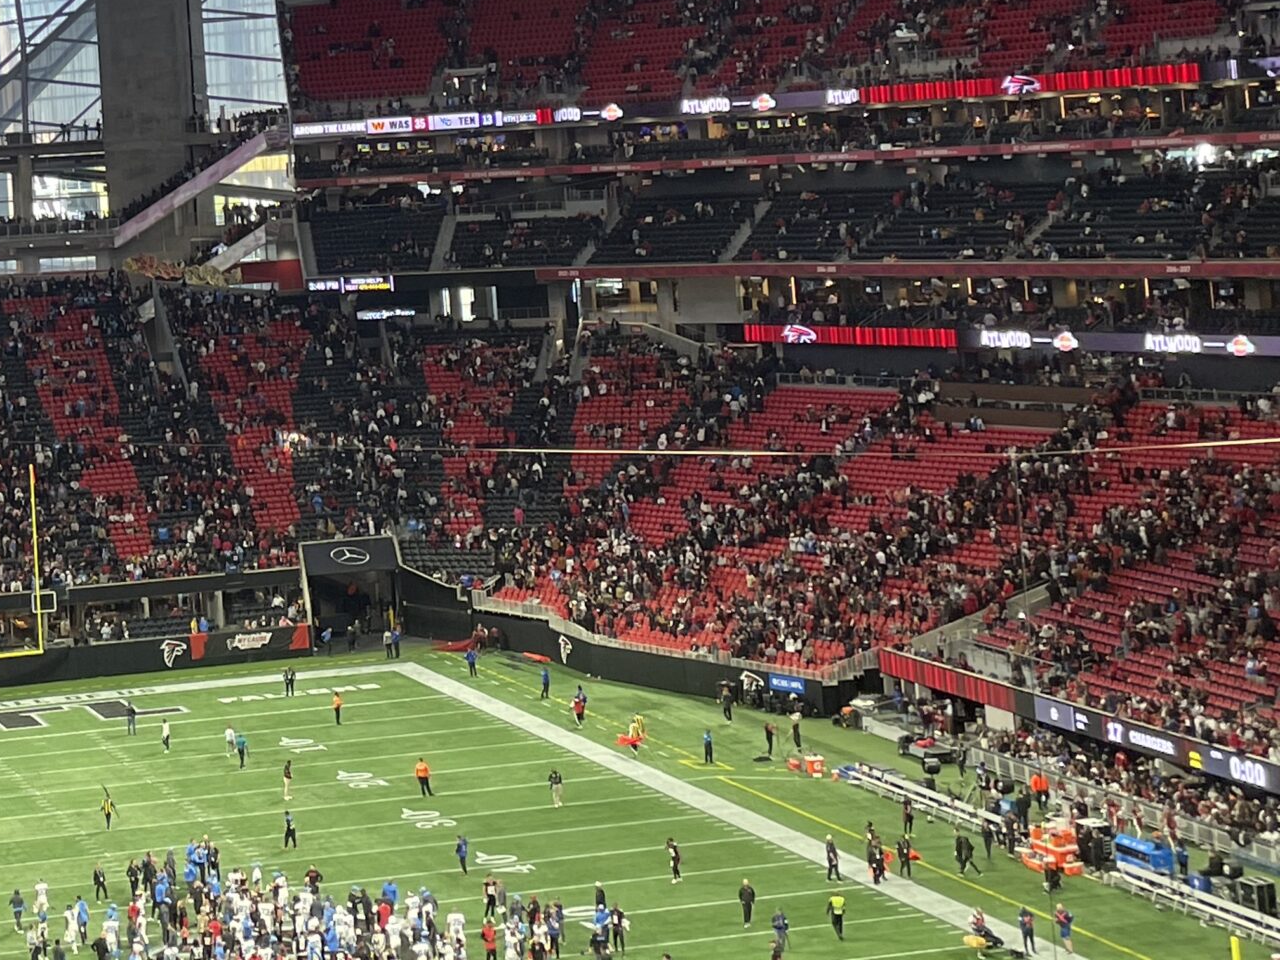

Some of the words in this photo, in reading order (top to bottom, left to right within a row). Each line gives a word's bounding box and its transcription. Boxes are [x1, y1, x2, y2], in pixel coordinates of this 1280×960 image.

[681, 97, 730, 114] ATLWOOD
[389, 120, 410, 129] WAS
[414, 118, 426, 129] 35
[458, 116, 476, 126] TEN
[326, 281, 339, 291] PM
[980, 330, 1031, 348] ATLWOOD
[1145, 332, 1201, 353] ATLWOOD
[1106, 721, 1123, 743] 17
[1229, 756, 1266, 787] 0:00
